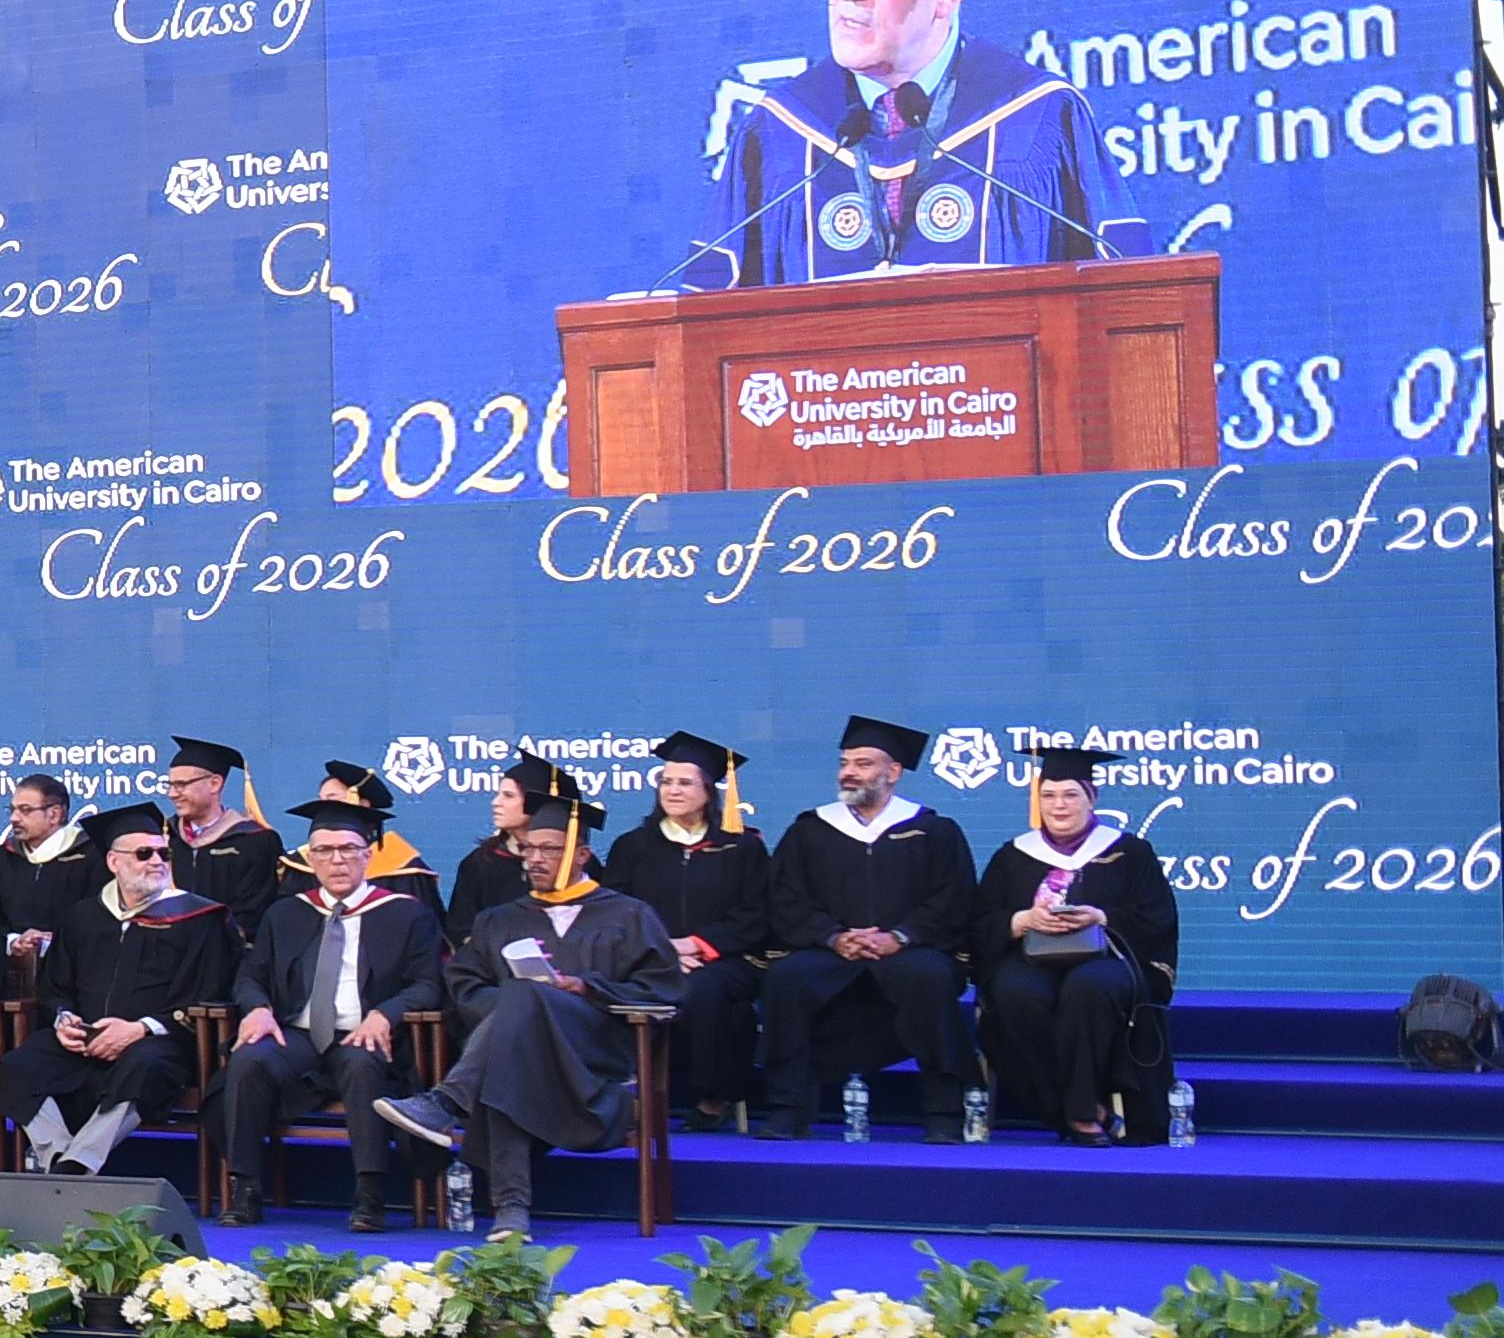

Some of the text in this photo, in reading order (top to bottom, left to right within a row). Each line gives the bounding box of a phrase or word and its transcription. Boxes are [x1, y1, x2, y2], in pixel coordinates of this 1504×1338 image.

[1256, 90, 1330, 164] in
[789, 360, 966, 393] The American
[790, 386, 1017, 424] University in Cairo
[8, 449, 204, 483] The American
[8, 476, 262, 513] University in Cairo
[1107, 456, 1419, 584] Class of
[538, 486, 955, 604] Class of 2026
[41, 511, 405, 621] Class of 2026
[19, 738, 156, 766] American
[1006, 721, 1259, 752] The American
[1193, 754, 1335, 785] in Cairo
[1240, 796, 1502, 920] of 2026
